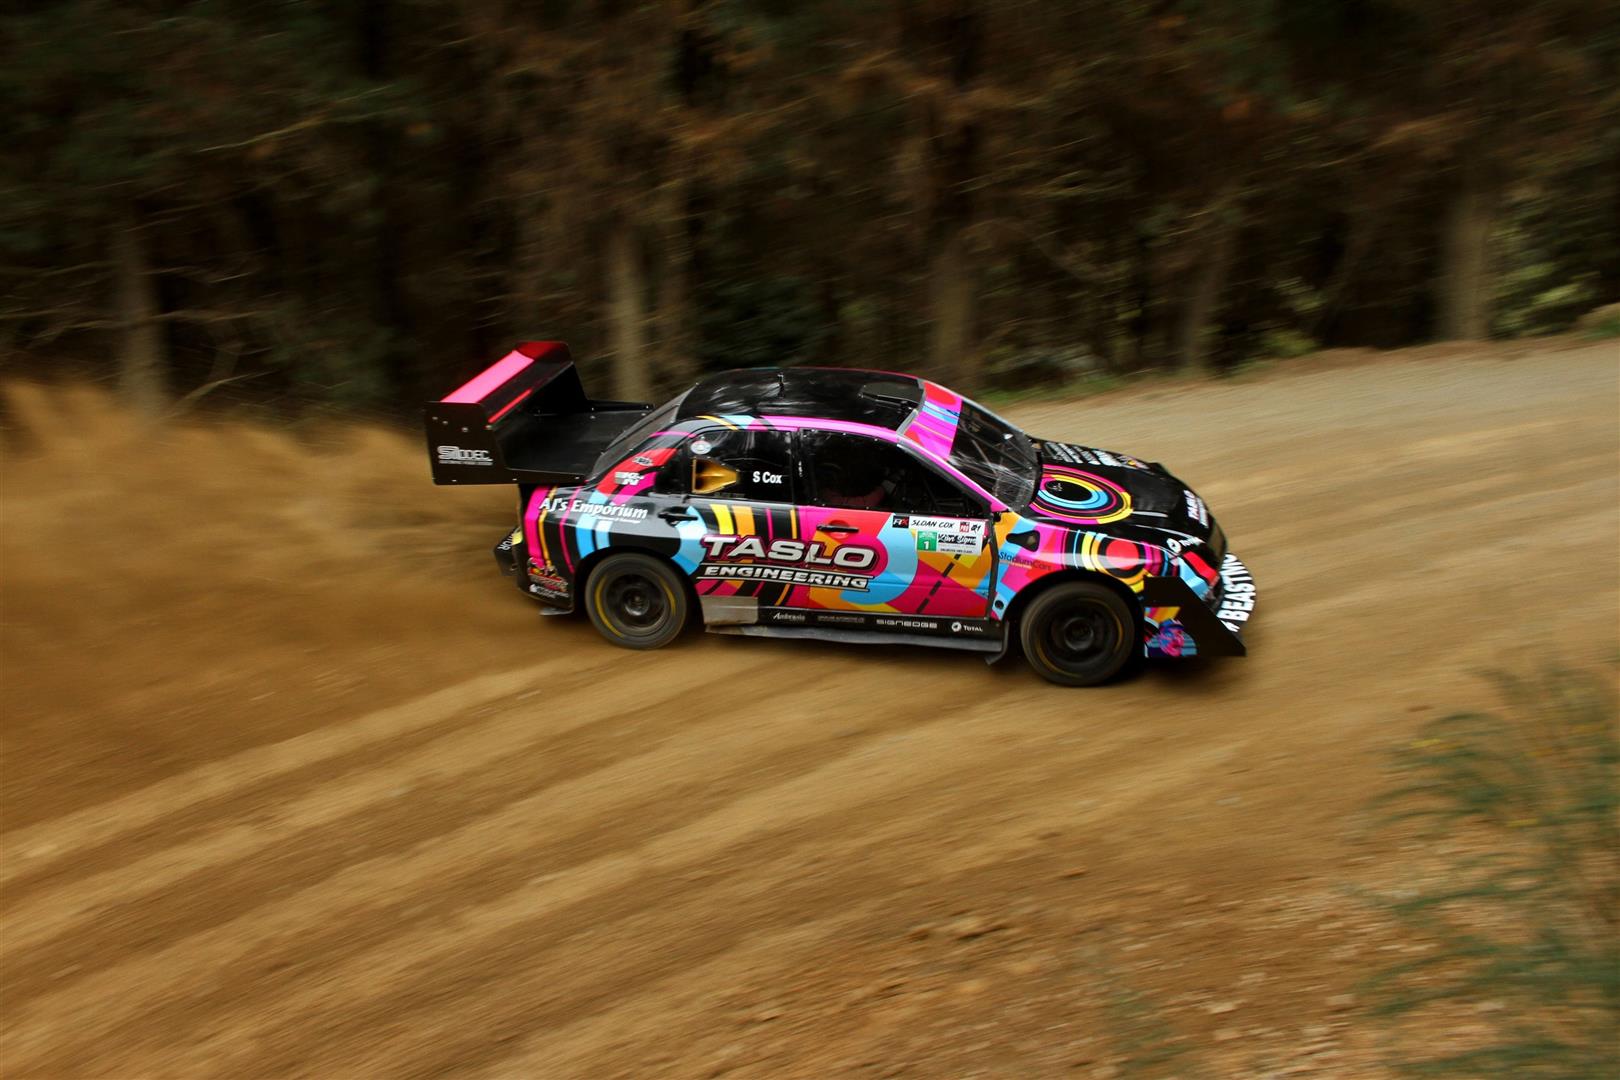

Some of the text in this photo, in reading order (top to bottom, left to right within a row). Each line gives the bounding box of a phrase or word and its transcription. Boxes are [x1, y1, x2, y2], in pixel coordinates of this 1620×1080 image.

[753, 471, 782, 484] S Cox
[539, 498, 648, 519] AJ's Emporium
[911, 519, 938, 528] SLOAN
[938, 521, 955, 529] COX
[703, 536, 875, 568] TASLO
[923, 541, 930, 550] 1
[703, 566, 868, 588] ENGINEERING
